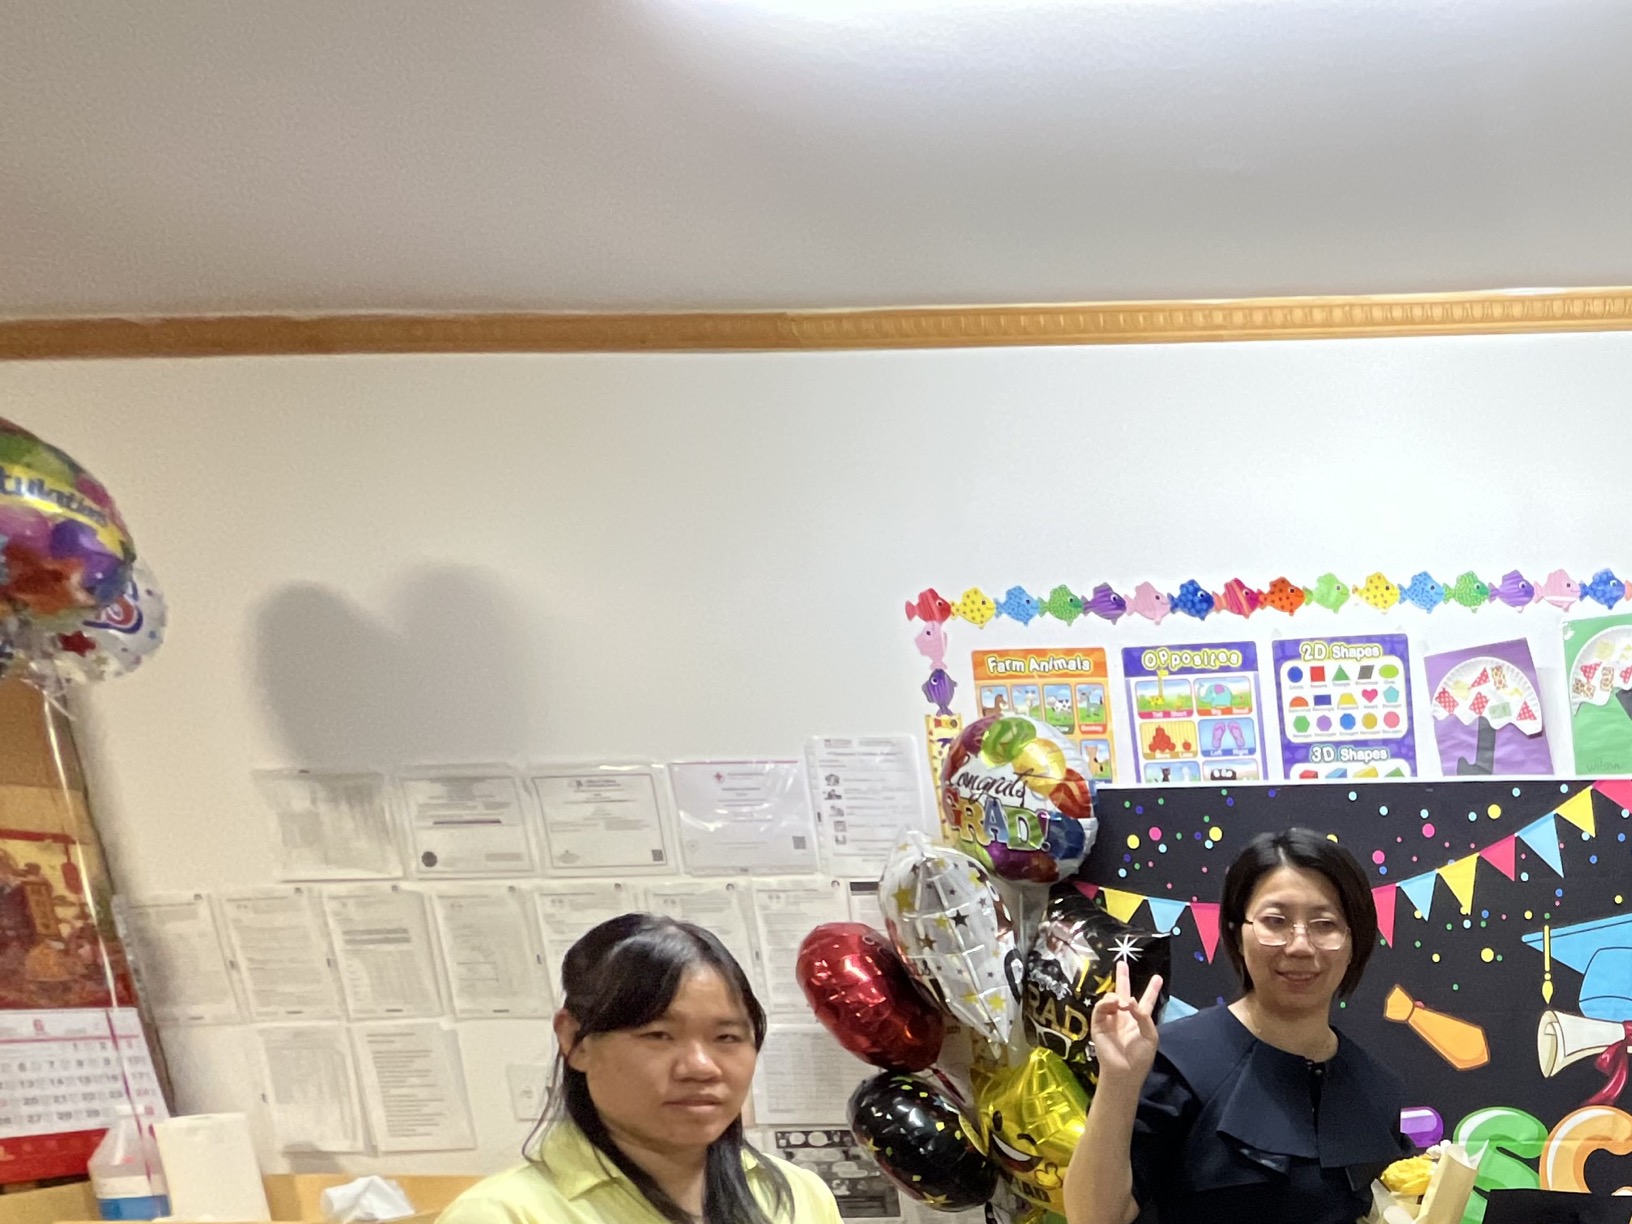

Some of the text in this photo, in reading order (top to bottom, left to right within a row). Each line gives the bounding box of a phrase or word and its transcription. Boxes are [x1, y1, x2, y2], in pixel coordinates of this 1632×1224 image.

[1142, 649, 1241, 670] Opposites
[1302, 643, 1381, 662] 2D Shapes
[986, 656, 1092, 673] Farm Animals
[1311, 746, 1389, 764] 3D Shapes
[1024, 983, 1090, 1042] RAD
